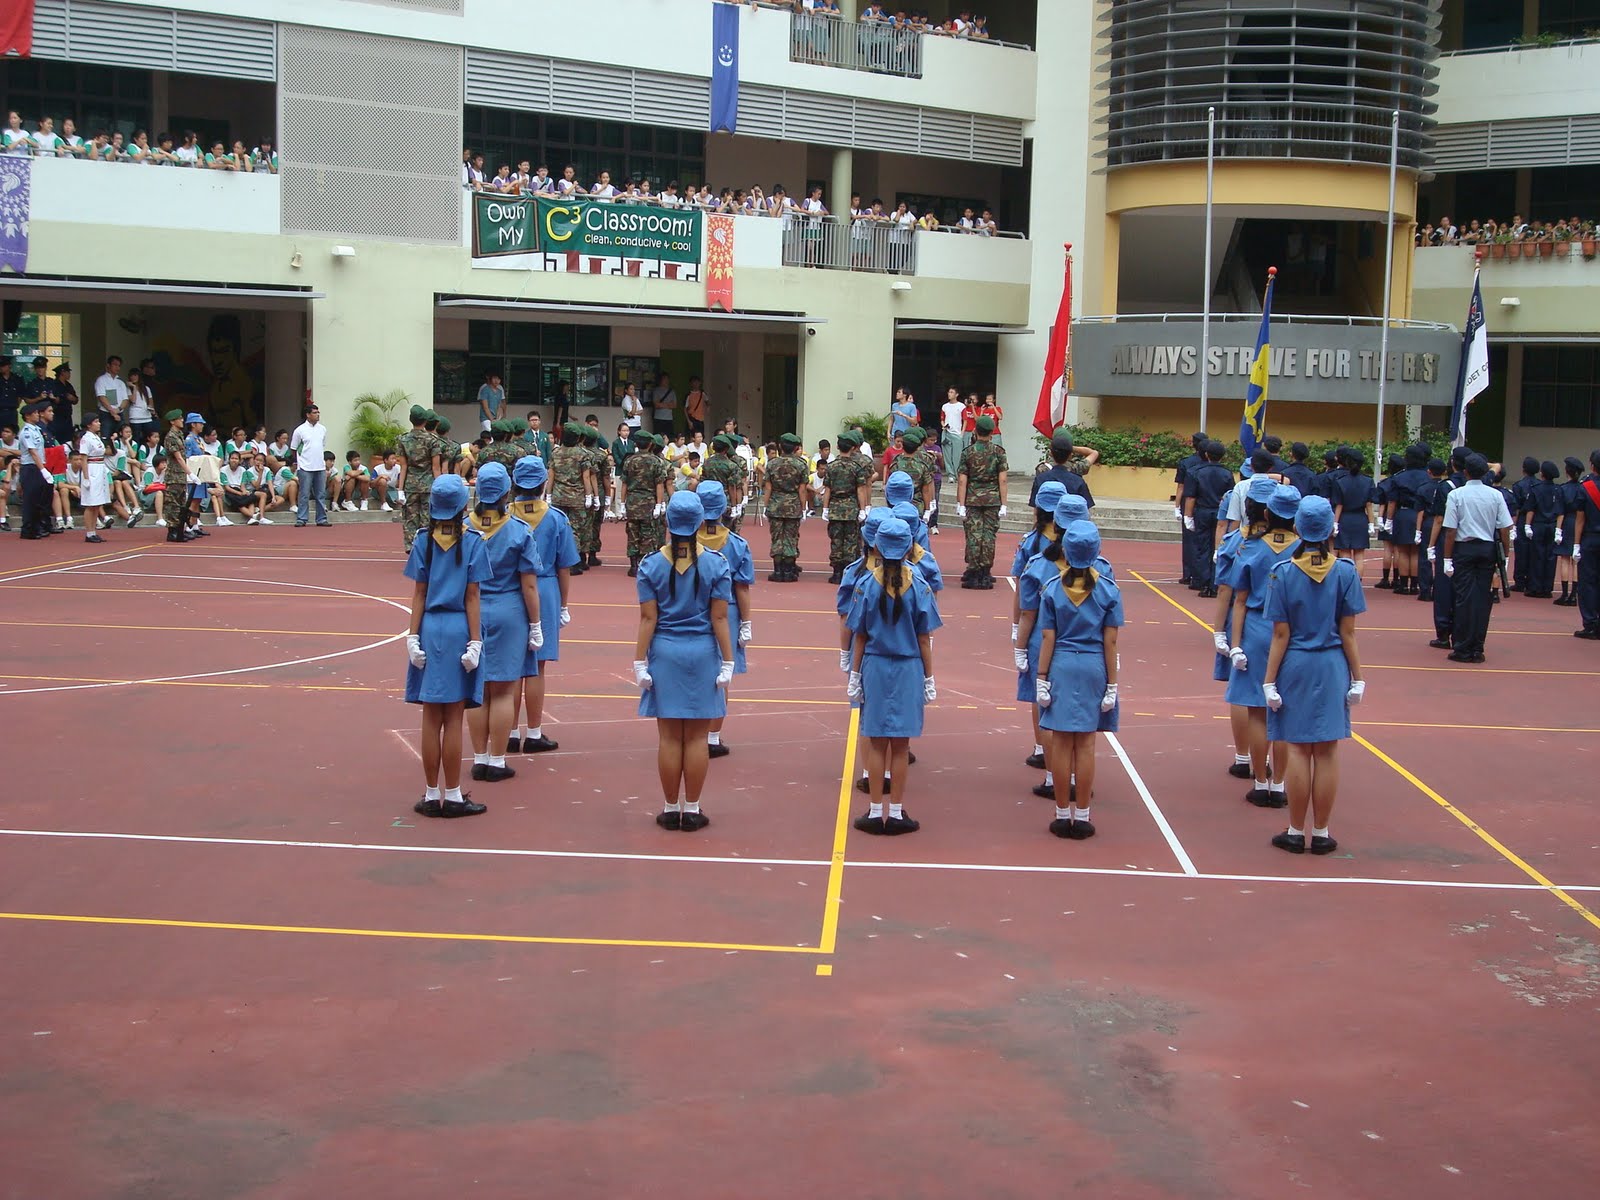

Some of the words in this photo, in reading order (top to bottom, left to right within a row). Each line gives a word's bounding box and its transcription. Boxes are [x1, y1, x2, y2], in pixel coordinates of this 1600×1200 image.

[487, 203, 526, 222] Own
[586, 208, 693, 237] Classroom!
[499, 226, 523, 246] My
[1111, 344, 1197, 375] ALWAYS
[1207, 345, 1297, 377] STRVE
[1305, 348, 1351, 379] FOR
